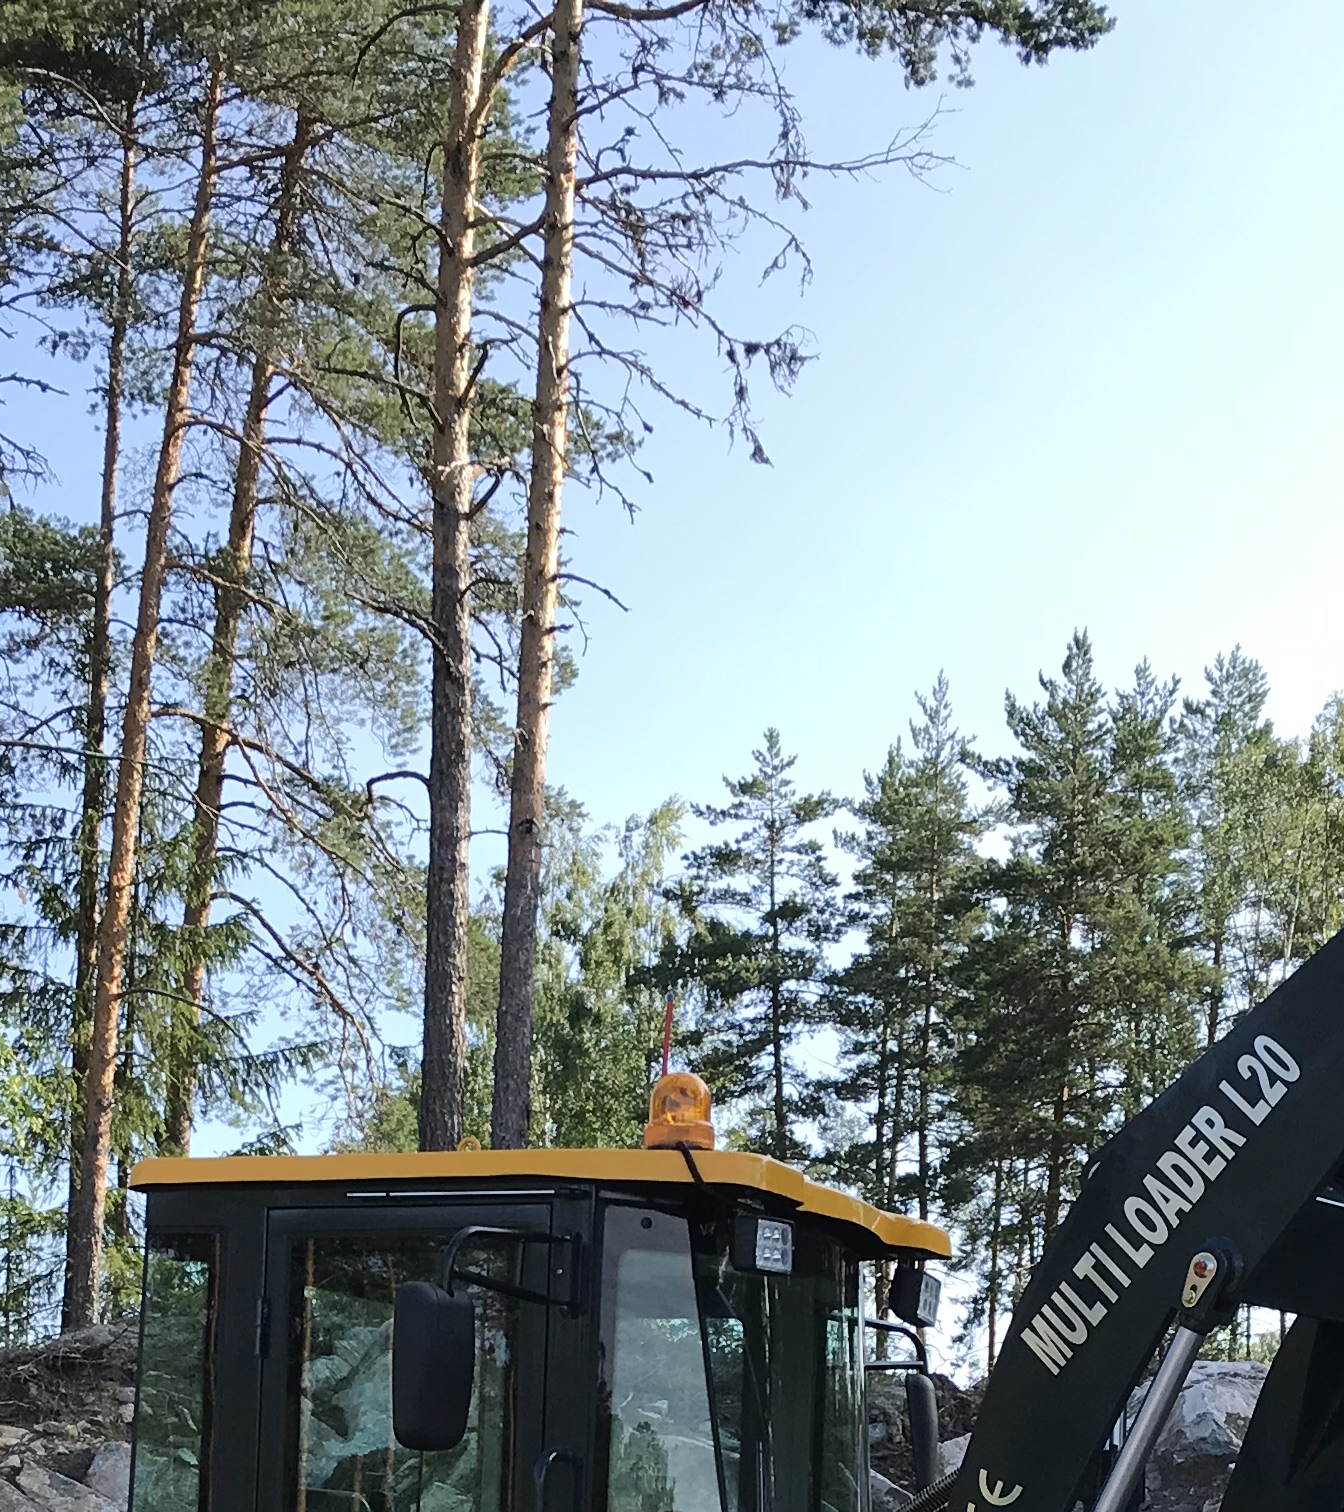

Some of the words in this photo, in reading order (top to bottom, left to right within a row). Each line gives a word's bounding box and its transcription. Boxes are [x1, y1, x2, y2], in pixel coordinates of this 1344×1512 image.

[1020, 1242, 1132, 1376] MULTI
[1104, 1105, 1247, 1269] LOADER
[1218, 1034, 1301, 1127] L20
